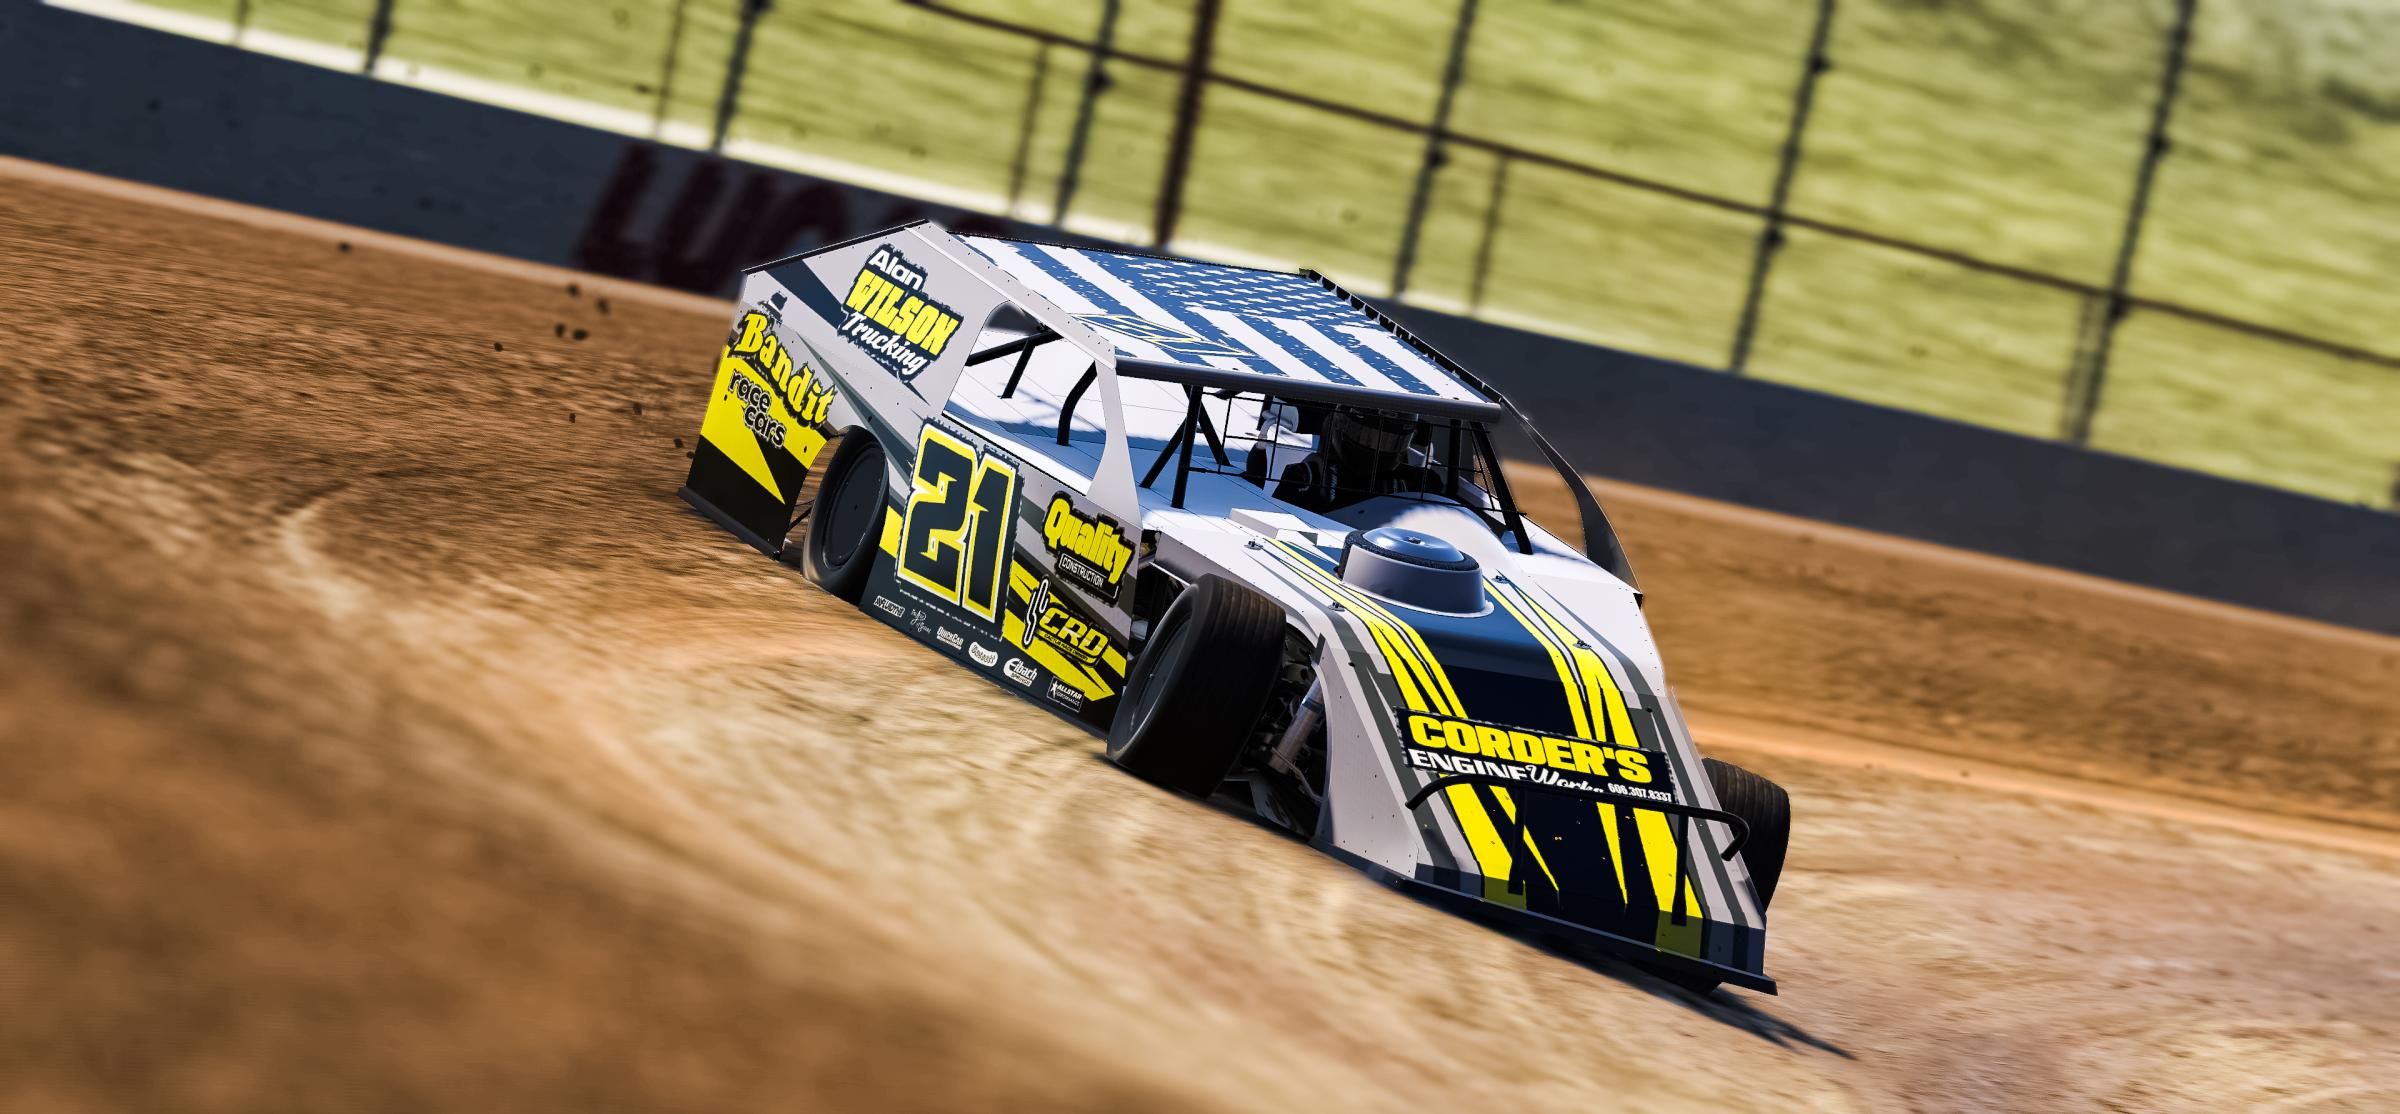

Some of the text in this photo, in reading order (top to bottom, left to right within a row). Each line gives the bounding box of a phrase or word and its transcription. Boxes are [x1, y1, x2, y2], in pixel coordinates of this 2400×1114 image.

[868, 248, 923, 290] Alan
[846, 268, 959, 356] WILSON
[842, 311, 929, 376] Trucking
[728, 369, 772, 413] race
[734, 312, 838, 424] Bandit
[743, 404, 788, 448] cars
[897, 423, 1016, 623] 21
[1044, 498, 1132, 585] Quality
[1061, 556, 1105, 588] CONSTRUCTION
[1039, 607, 1109, 657] CRD
[1003, 657, 1038, 681] Eibach
[1056, 683, 1083, 700] ALLSTAR
[1408, 715, 1652, 784] CORDER'S
[1607, 782, 1672, 803] 606.307.8337
